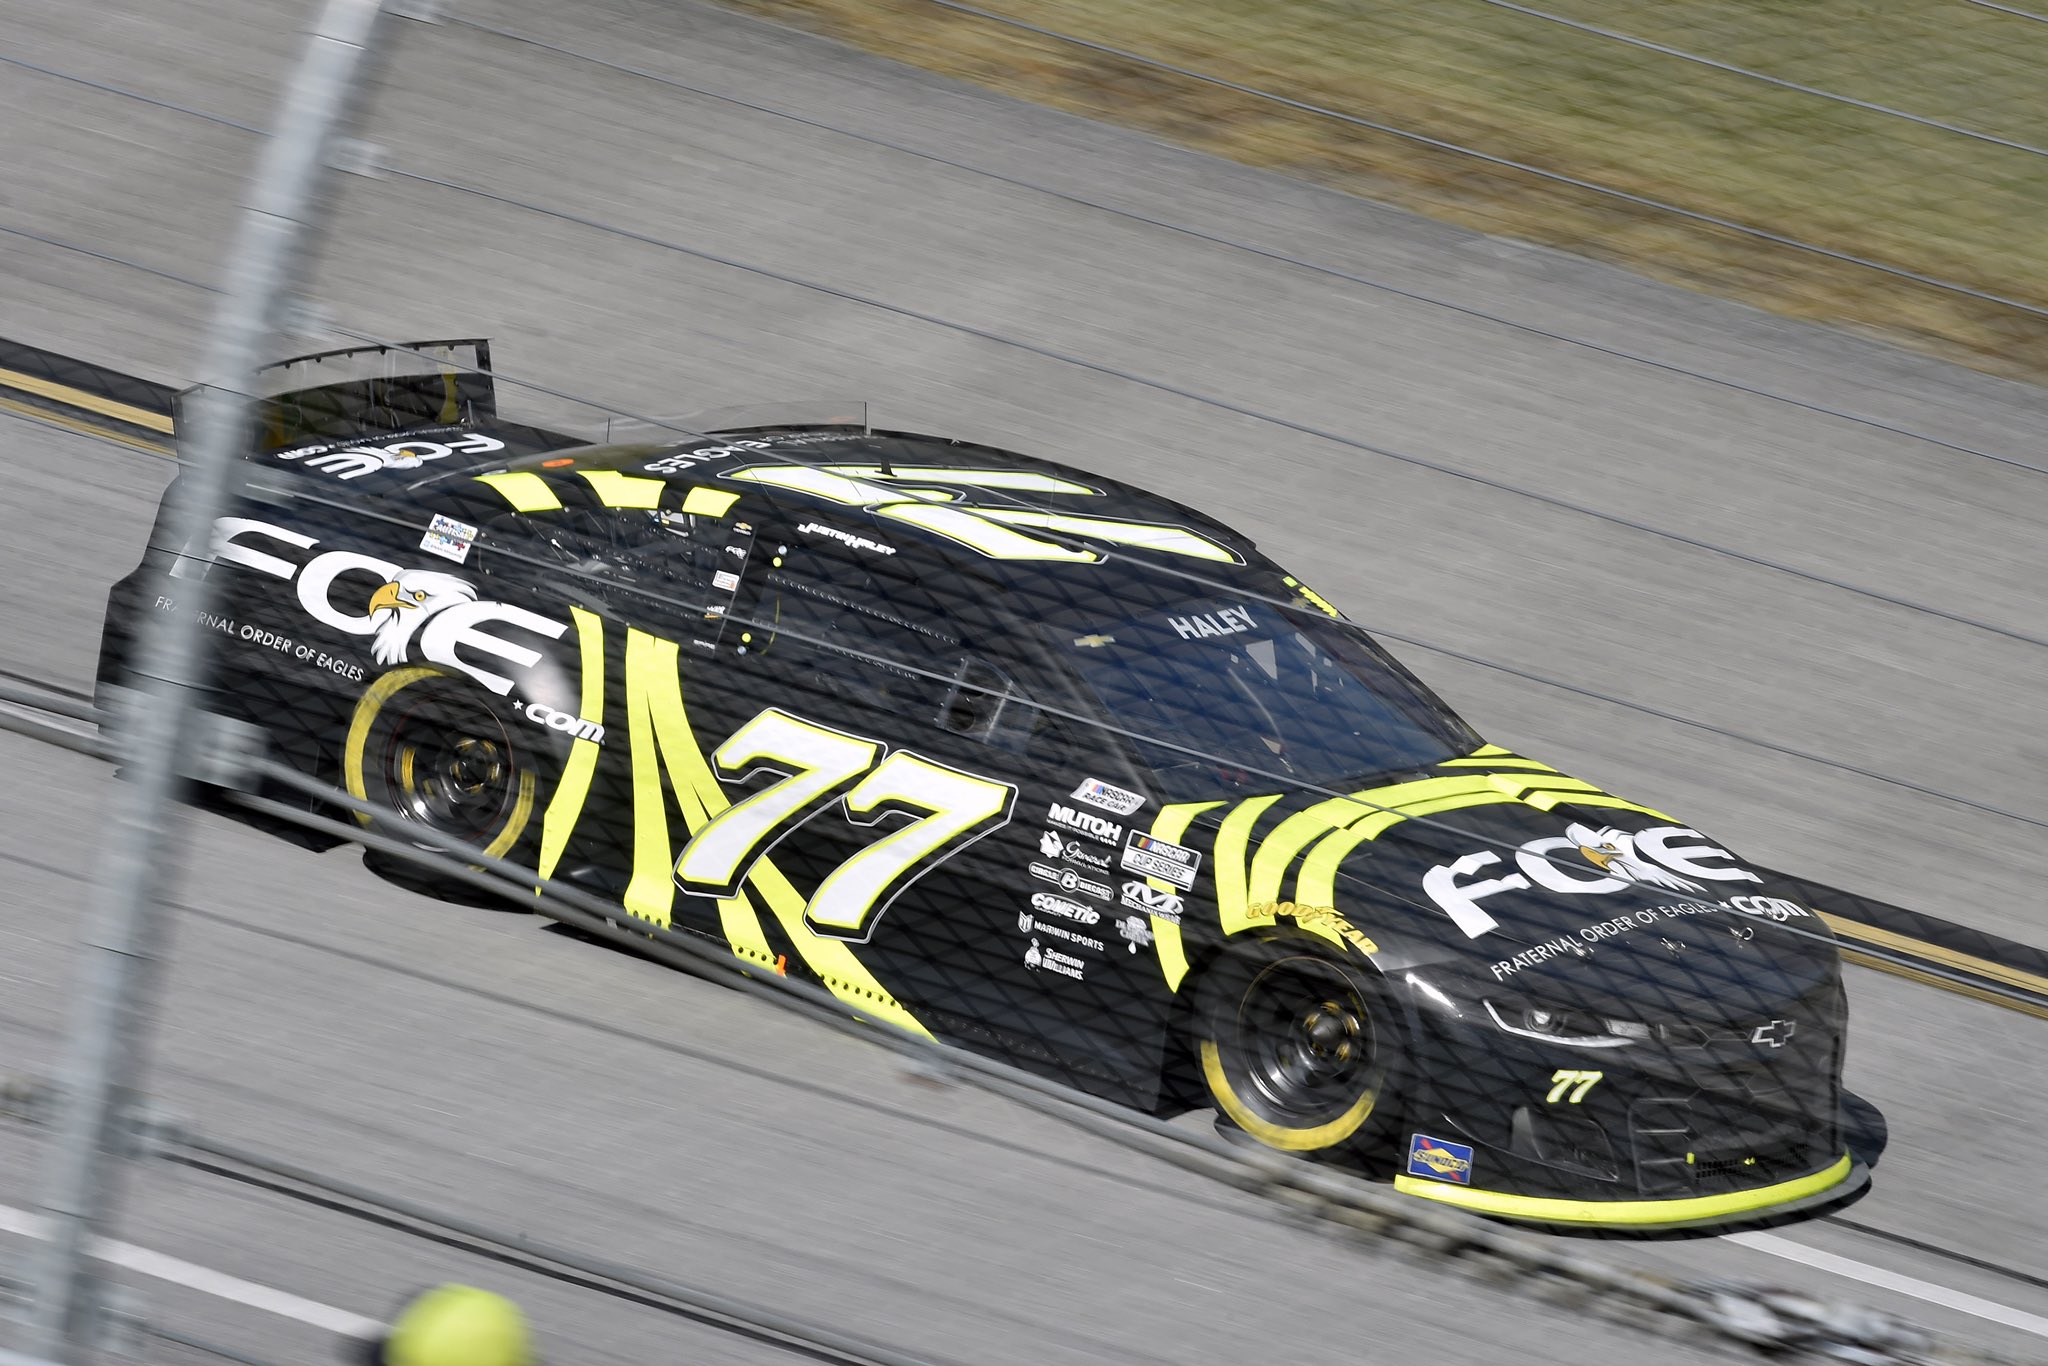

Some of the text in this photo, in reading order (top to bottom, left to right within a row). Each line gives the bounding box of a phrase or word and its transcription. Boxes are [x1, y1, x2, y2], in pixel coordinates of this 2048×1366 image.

[155, 596, 364, 682] FRRNAL ORDER OF EAGLES
[1167, 605, 1258, 640] HALEY
[672, 707, 1018, 943] 77
[1047, 802, 1122, 841] MUTOH
[1061, 871, 1078, 889] B
[1422, 823, 1764, 939] FOE
[1031, 892, 1101, 925] COMETIC
[1070, 932, 1105, 952] SPORTS
[1246, 901, 1379, 955] GOODYEAR
[1489, 935, 1583, 982] FRATERNAL
[1580, 914, 1638, 943] ORDER
[1635, 907, 1660, 924] OF
[1042, 957, 1084, 981] WILLIAMS
[1546, 1069, 1603, 1104] 77
